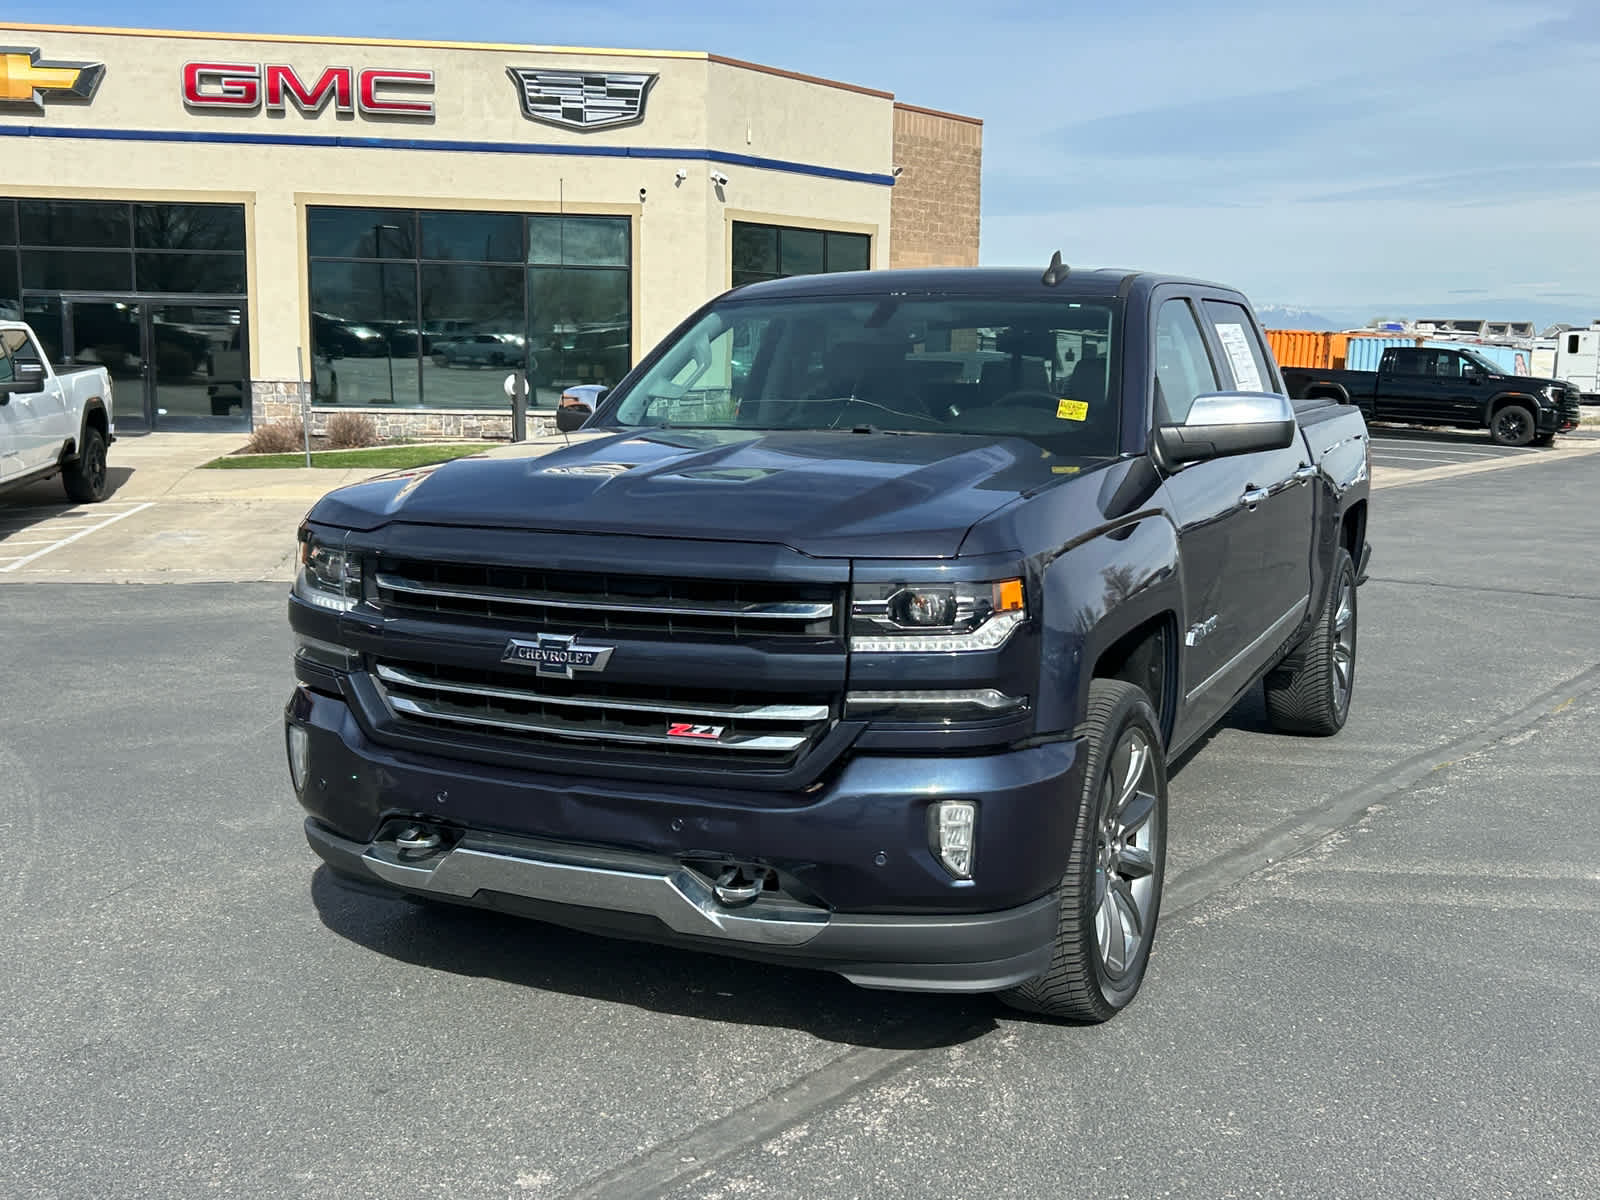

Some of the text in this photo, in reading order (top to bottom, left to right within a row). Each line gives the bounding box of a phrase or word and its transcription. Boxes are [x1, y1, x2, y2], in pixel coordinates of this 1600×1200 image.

[182, 60, 435, 116] GMC
[518, 647, 592, 664] CHEVROLET
[666, 722, 725, 739] Z71
